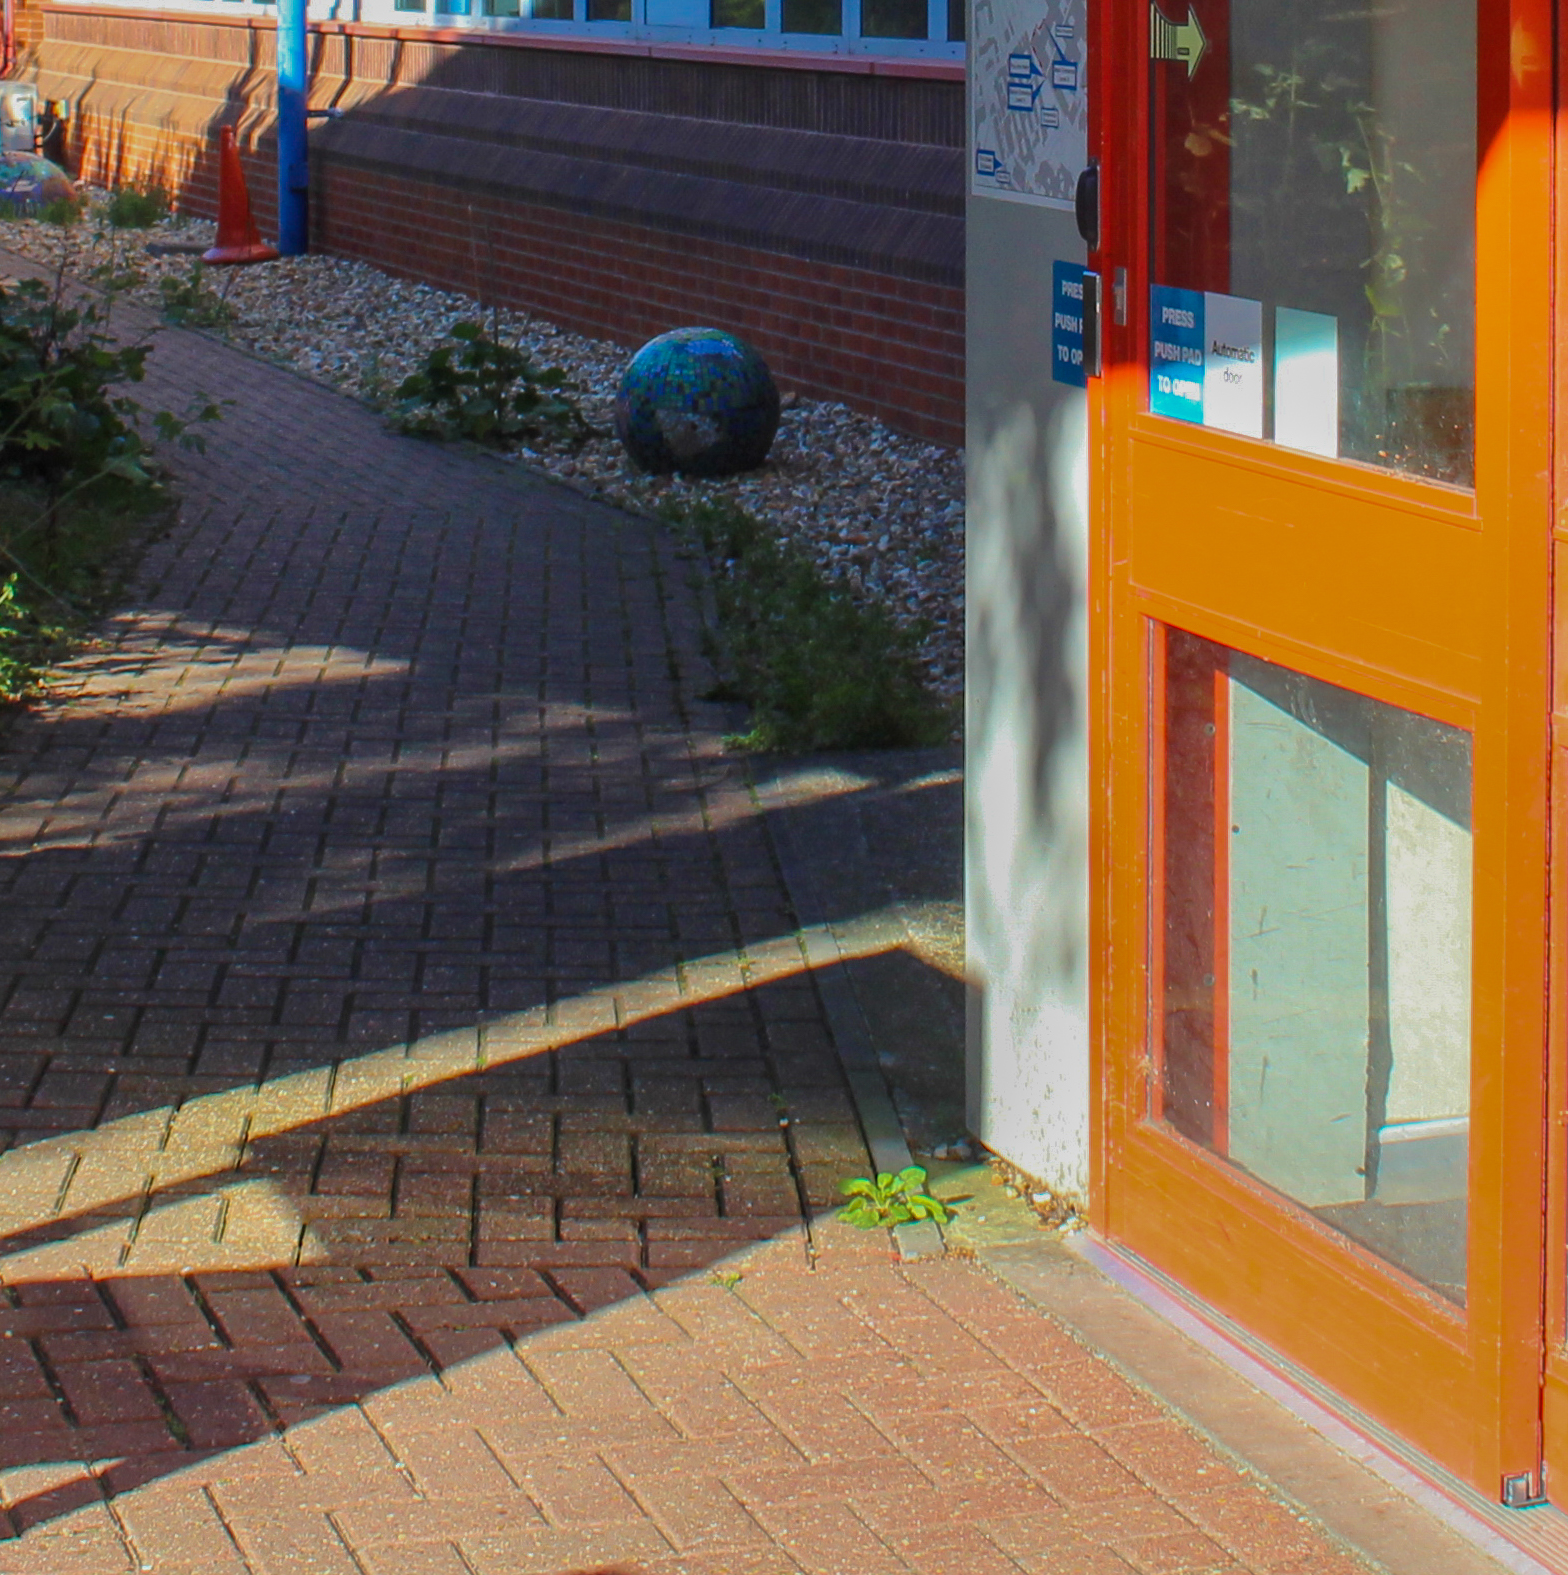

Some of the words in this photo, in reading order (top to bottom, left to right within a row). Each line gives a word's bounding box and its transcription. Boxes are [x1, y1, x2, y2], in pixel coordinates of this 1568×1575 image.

[1062, 280, 1083, 300] PRES
[1055, 312, 1078, 333] PUSH
[1162, 305, 1195, 329] PRESS
[1057, 343, 1069, 362] TO
[1070, 347, 1083, 366] OP
[1154, 339, 1181, 363] PUSH
[1182, 345, 1203, 367] PAD
[1212, 339, 1256, 364] Automatic
[1157, 373, 1171, 394] TO
[1172, 380, 1201, 402] OPEN
[1223, 366, 1243, 386] door
